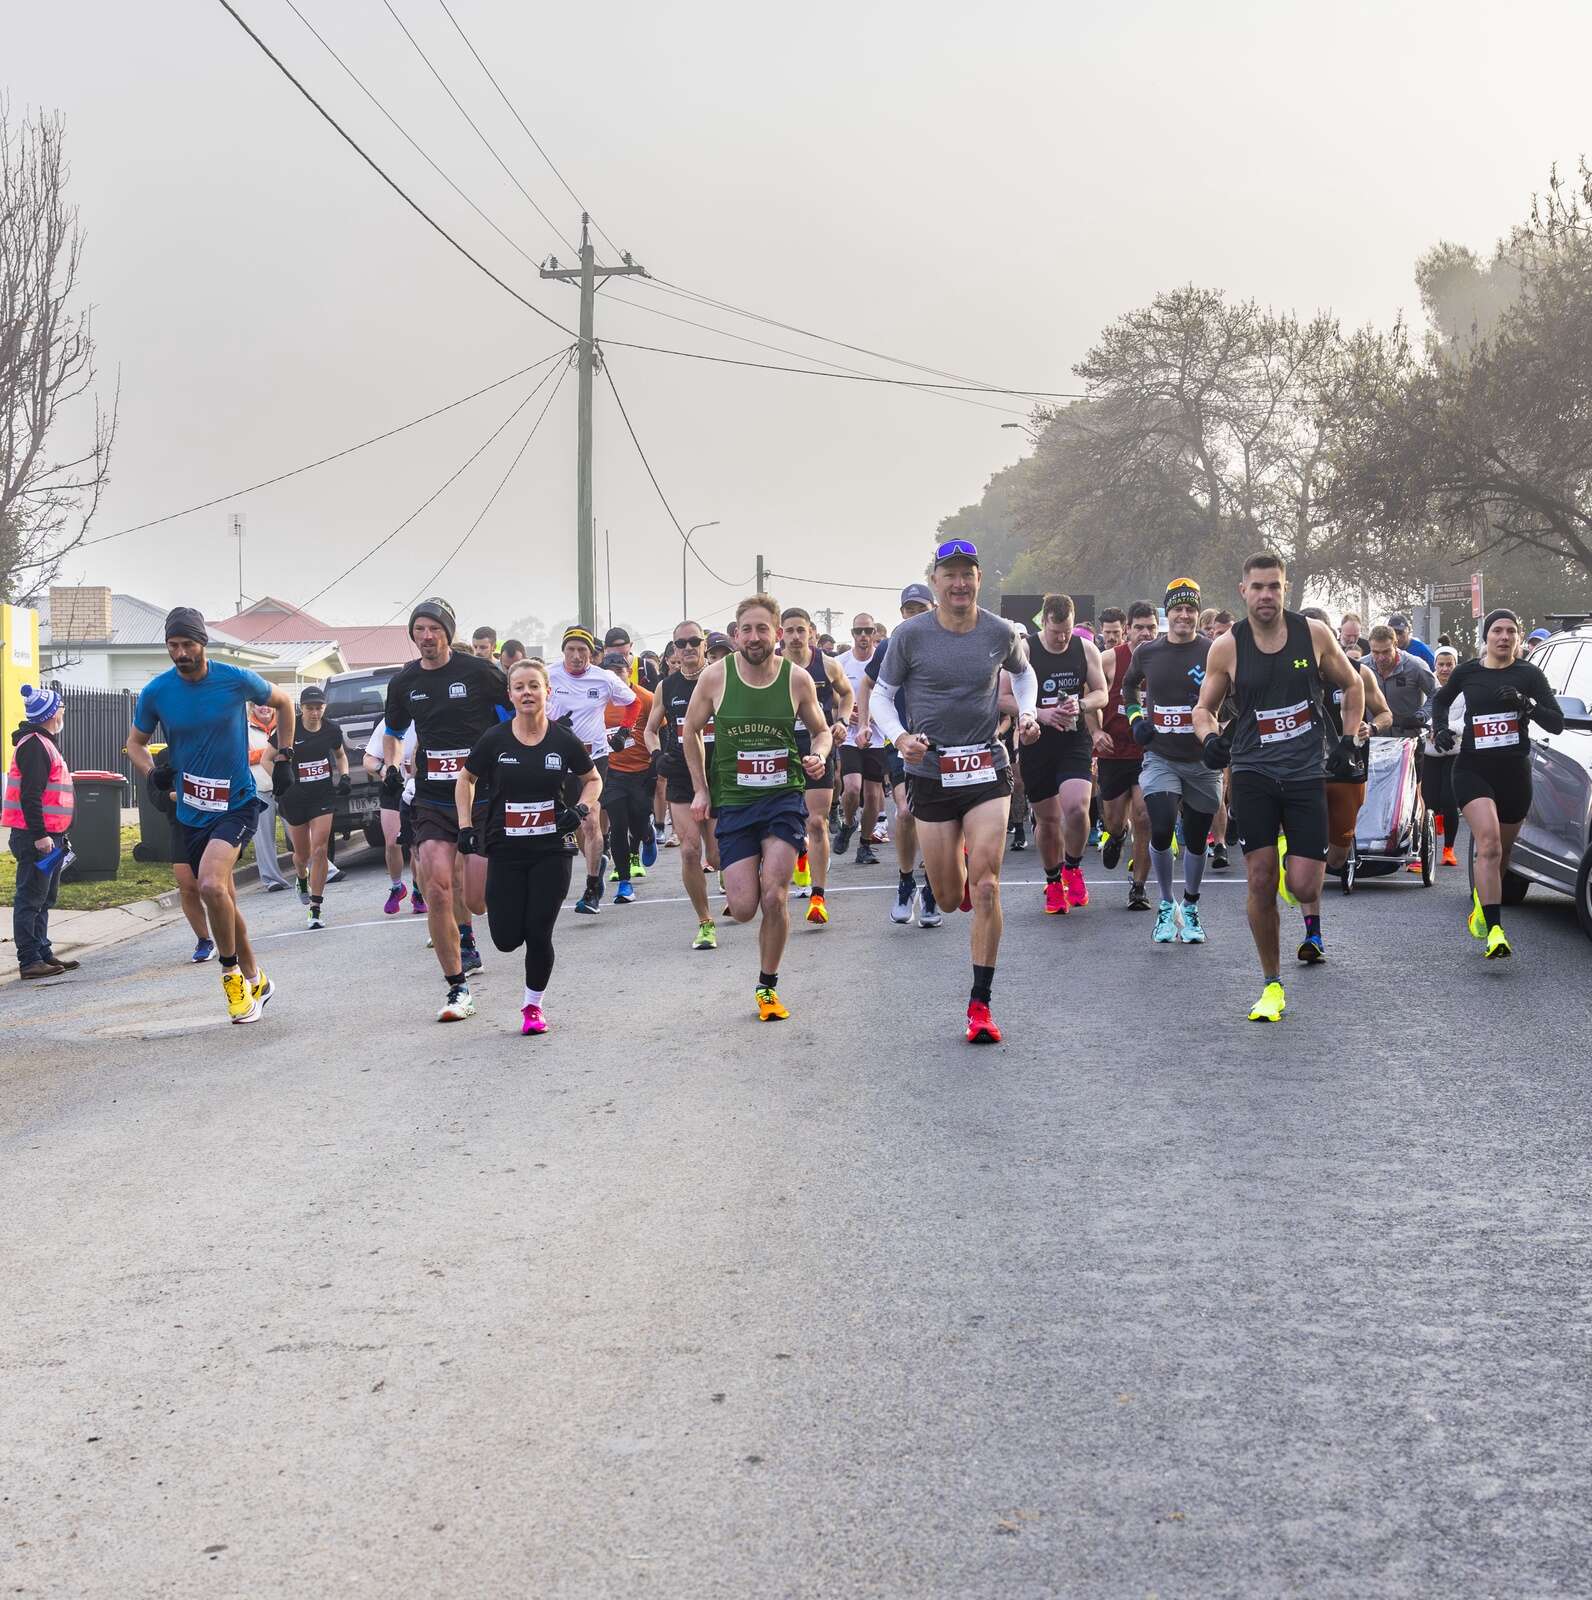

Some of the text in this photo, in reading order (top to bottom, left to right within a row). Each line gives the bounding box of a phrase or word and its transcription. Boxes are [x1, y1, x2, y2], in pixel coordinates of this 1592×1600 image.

[1163, 715, 1181, 726] 89
[1275, 716, 1296, 731] 86
[1482, 722, 1509, 735] 130
[439, 759, 458, 771] 23
[752, 760, 775, 773] 116
[952, 755, 981, 771] 170
[306, 766, 324, 776] 156
[193, 785, 215, 800] 181
[520, 812, 541, 826] 77
